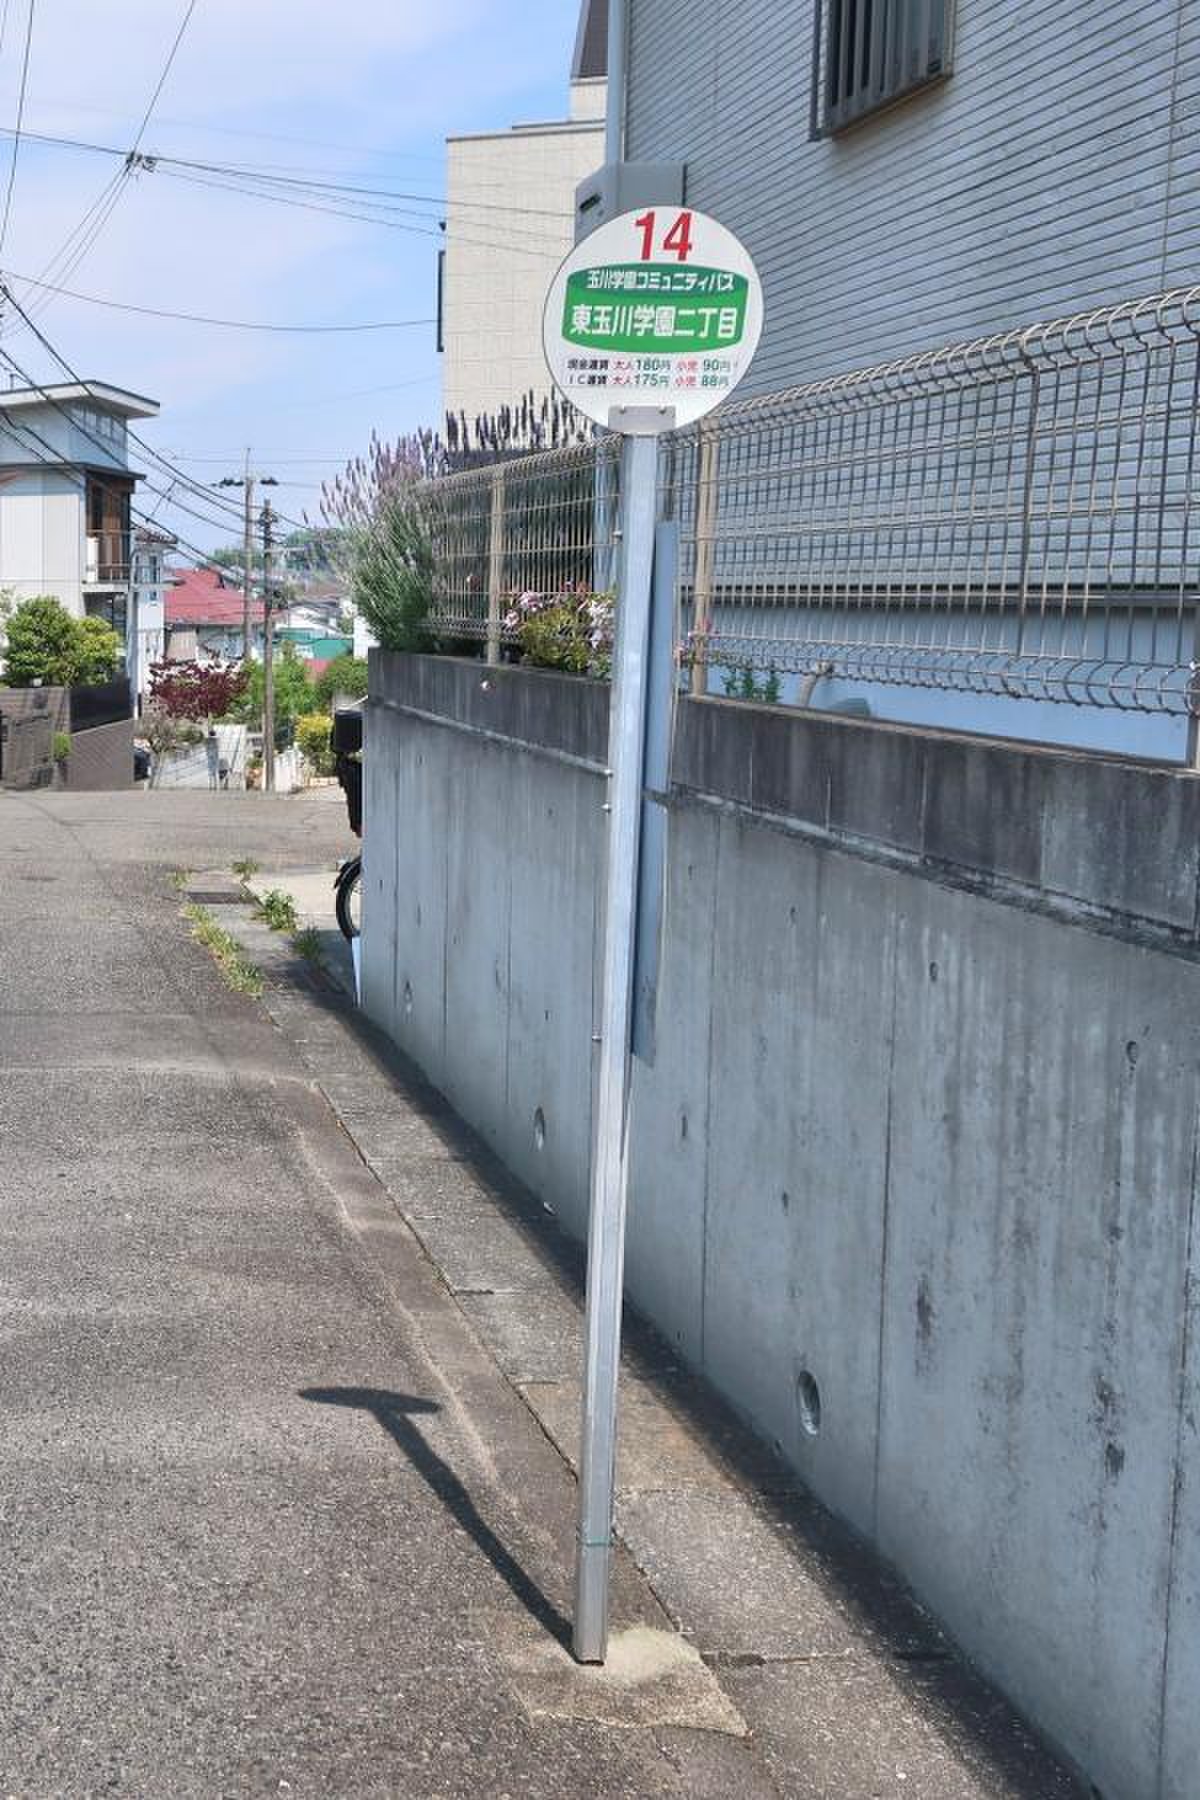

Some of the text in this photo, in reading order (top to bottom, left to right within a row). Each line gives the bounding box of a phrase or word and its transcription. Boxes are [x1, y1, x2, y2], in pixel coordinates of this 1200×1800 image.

[634, 210, 693, 262] 14
[586, 269, 735, 291] 玉川学園コミュニティバス
[570, 304, 737, 338] 東玉川学園二丁目
